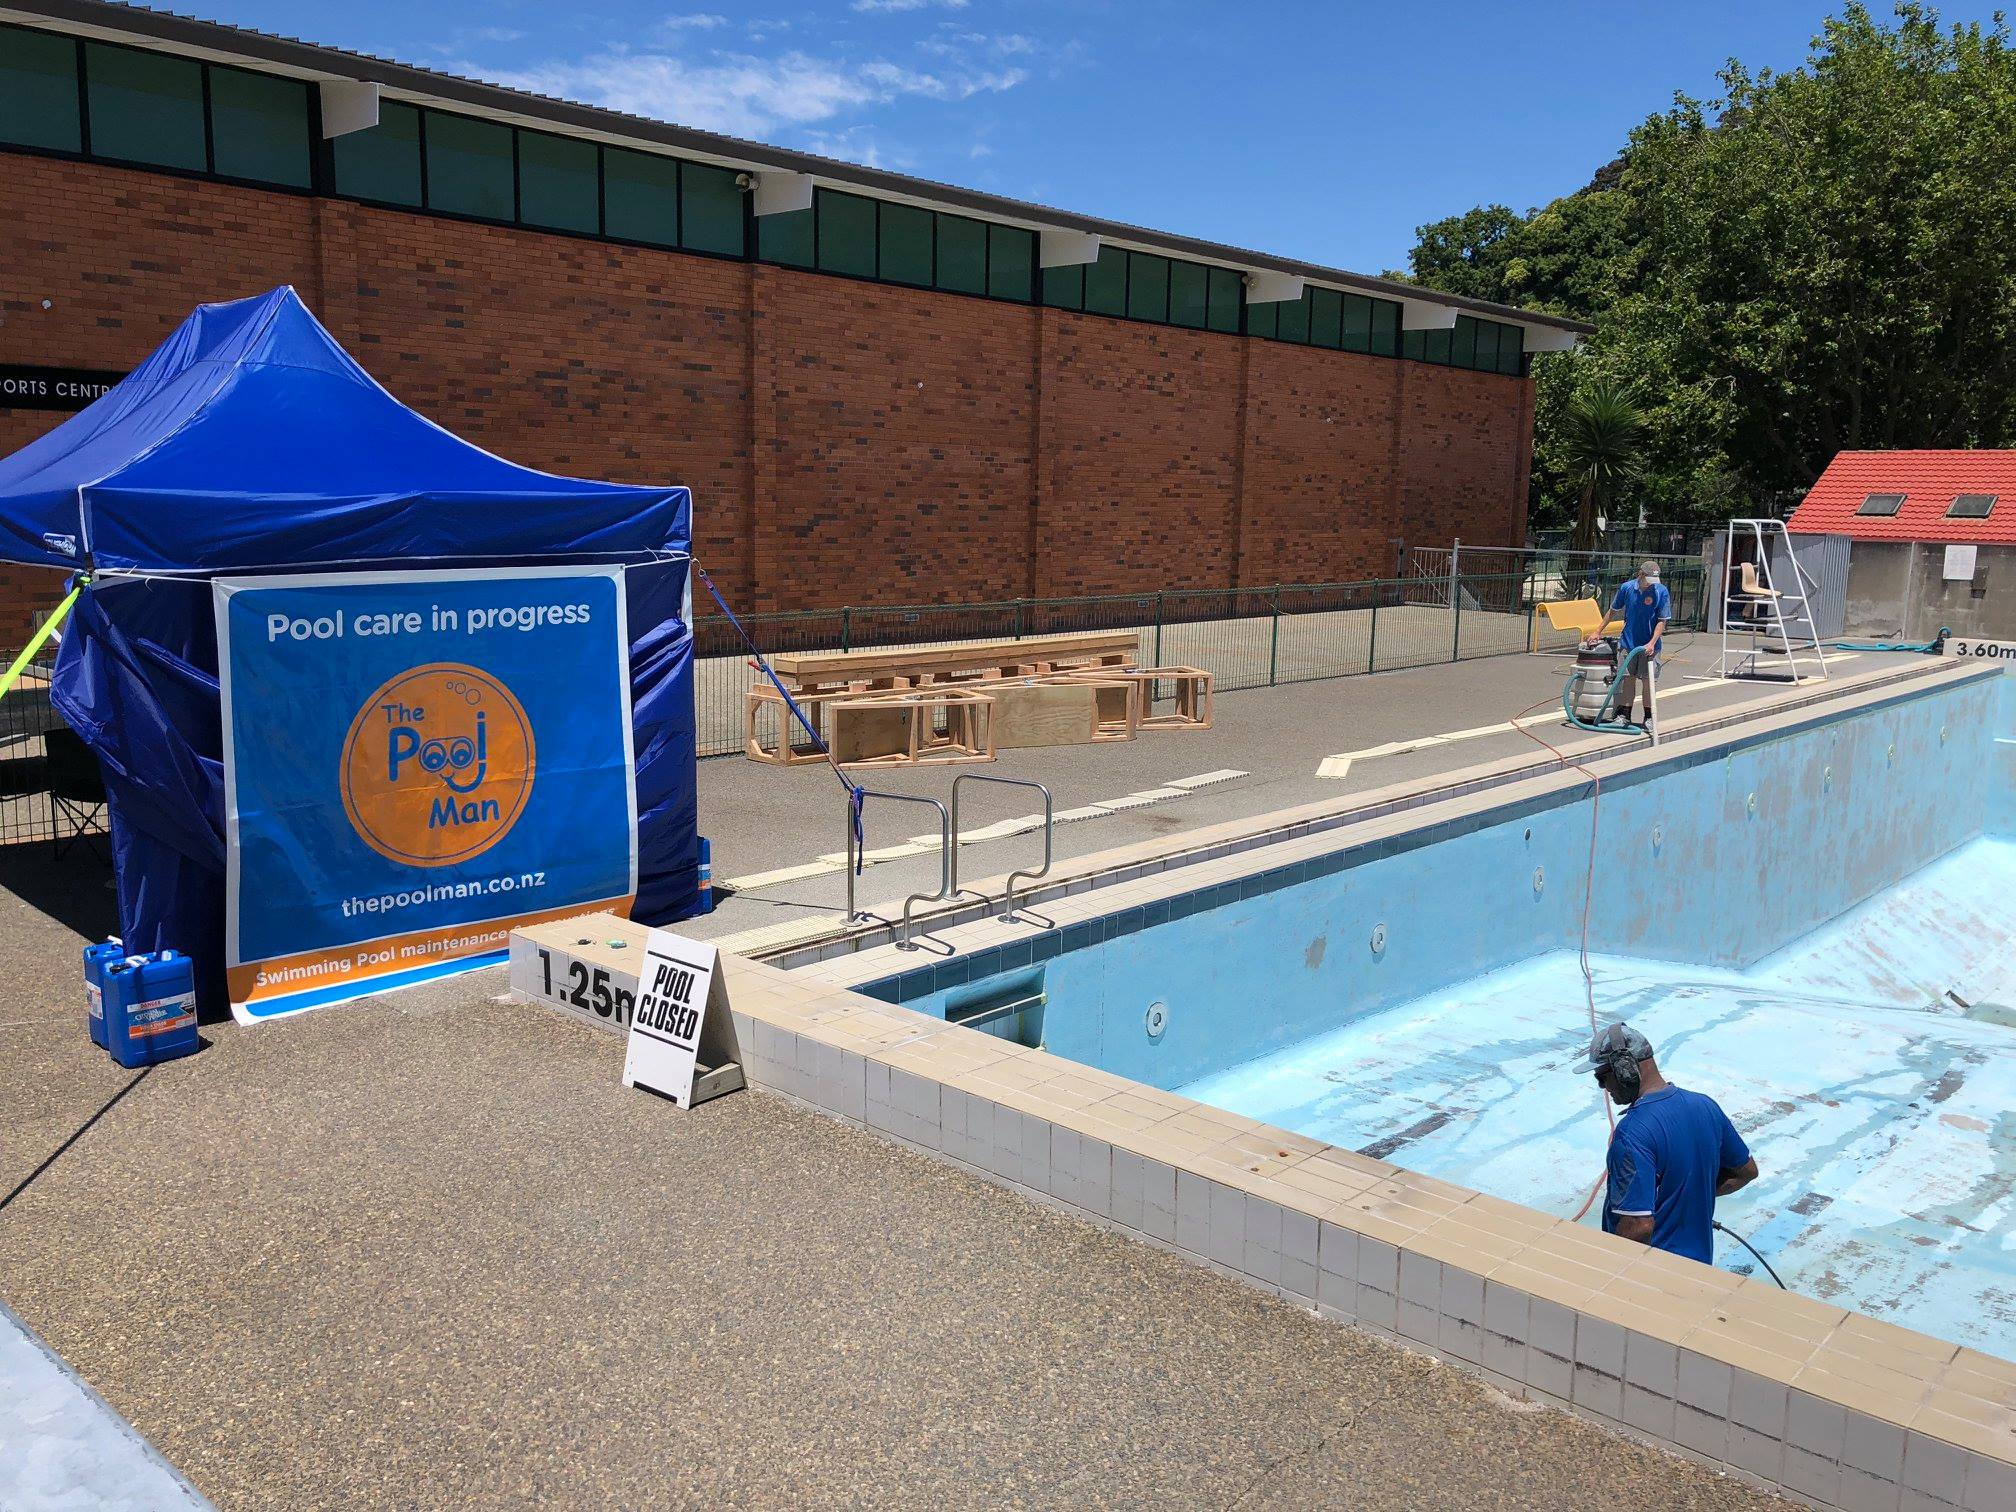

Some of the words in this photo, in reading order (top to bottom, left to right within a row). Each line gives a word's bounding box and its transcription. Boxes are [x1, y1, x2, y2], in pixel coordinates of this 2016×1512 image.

[0, 379, 47, 395] ORTS
[56, 382, 115, 398] CENTR
[267, 609, 343, 642] Pool
[353, 612, 422, 636] care
[431, 604, 458, 632] in
[467, 603, 591, 635] progress
[1956, 642, 2016, 659] 3.60m
[381, 703, 425, 723] The
[428, 796, 500, 829] Man
[341, 871, 546, 917] thepoolman.co.nz
[256, 959, 351, 987] Swimming
[357, 946, 396, 966] Pool
[401, 930, 508, 958] maintenance
[652, 963, 695, 1004] POOL
[637, 994, 699, 1041] CLOSED
